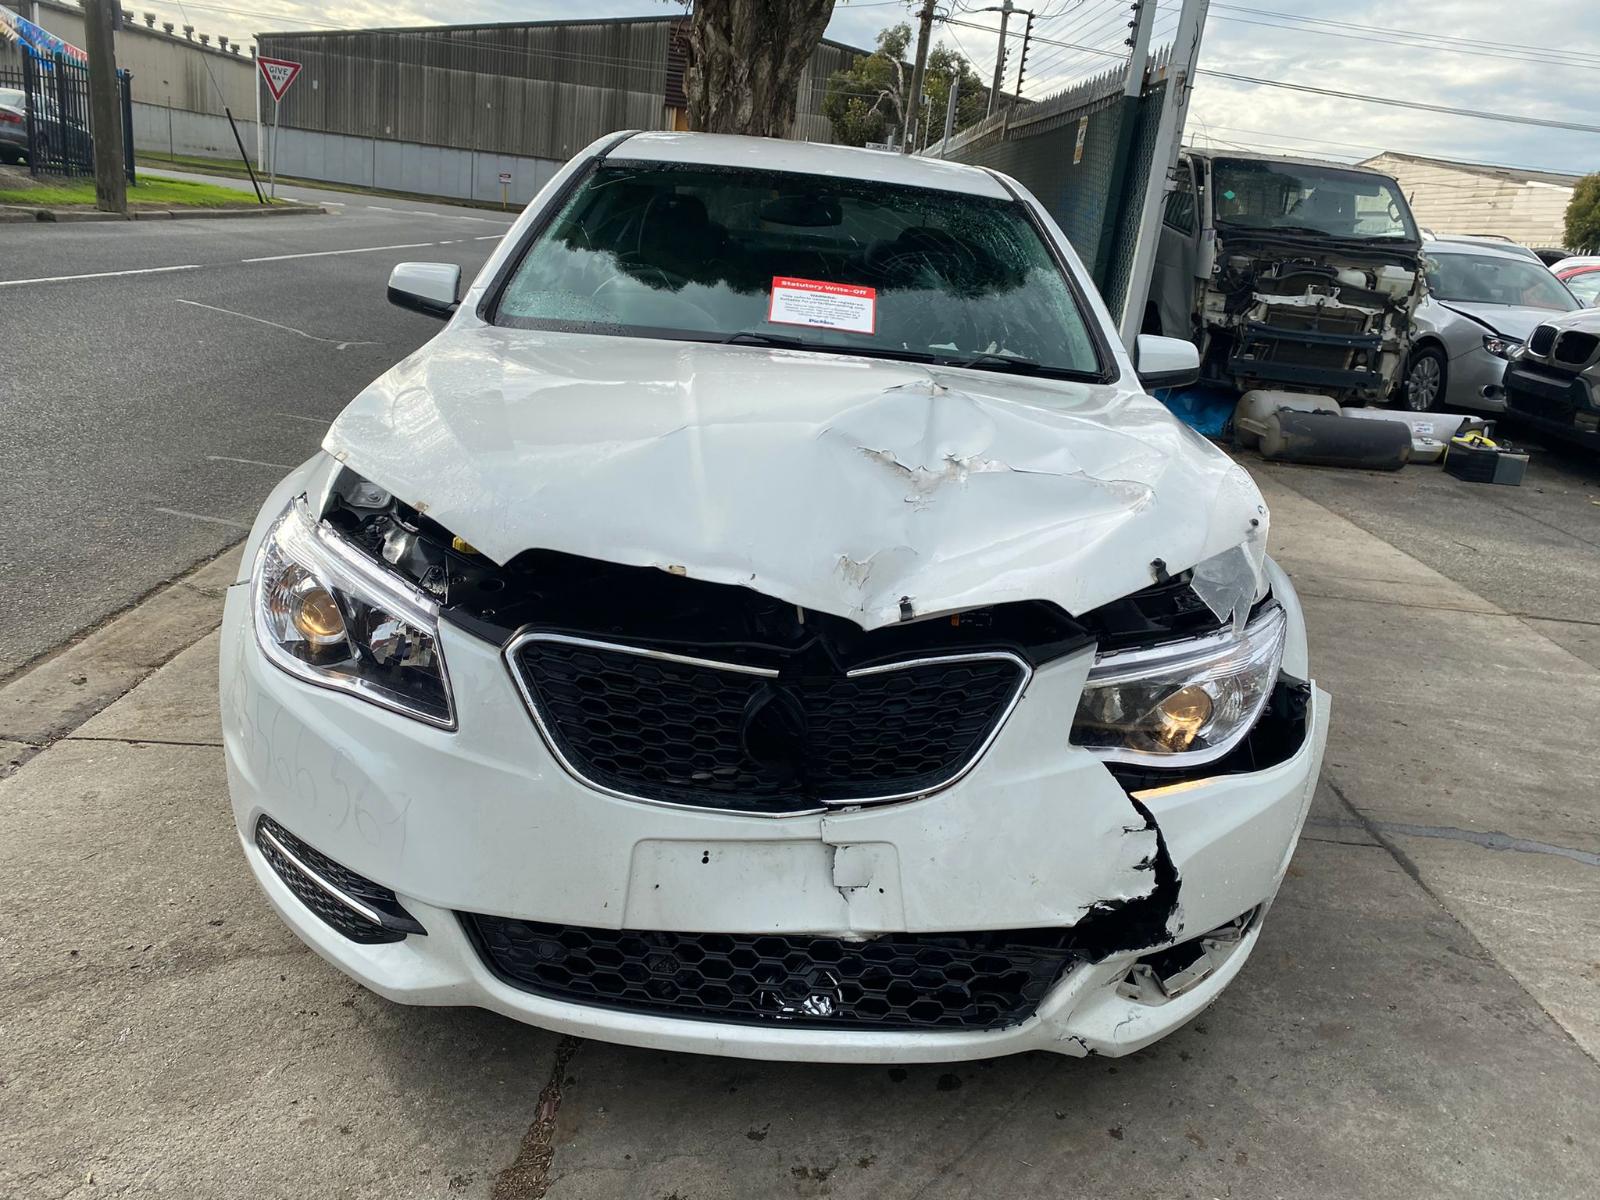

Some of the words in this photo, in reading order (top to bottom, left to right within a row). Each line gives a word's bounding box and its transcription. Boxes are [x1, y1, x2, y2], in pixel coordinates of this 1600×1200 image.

[269, 65, 289, 76] GIVE
[782, 281, 822, 291] Statutory
[824, 286, 867, 296] Write-Off
